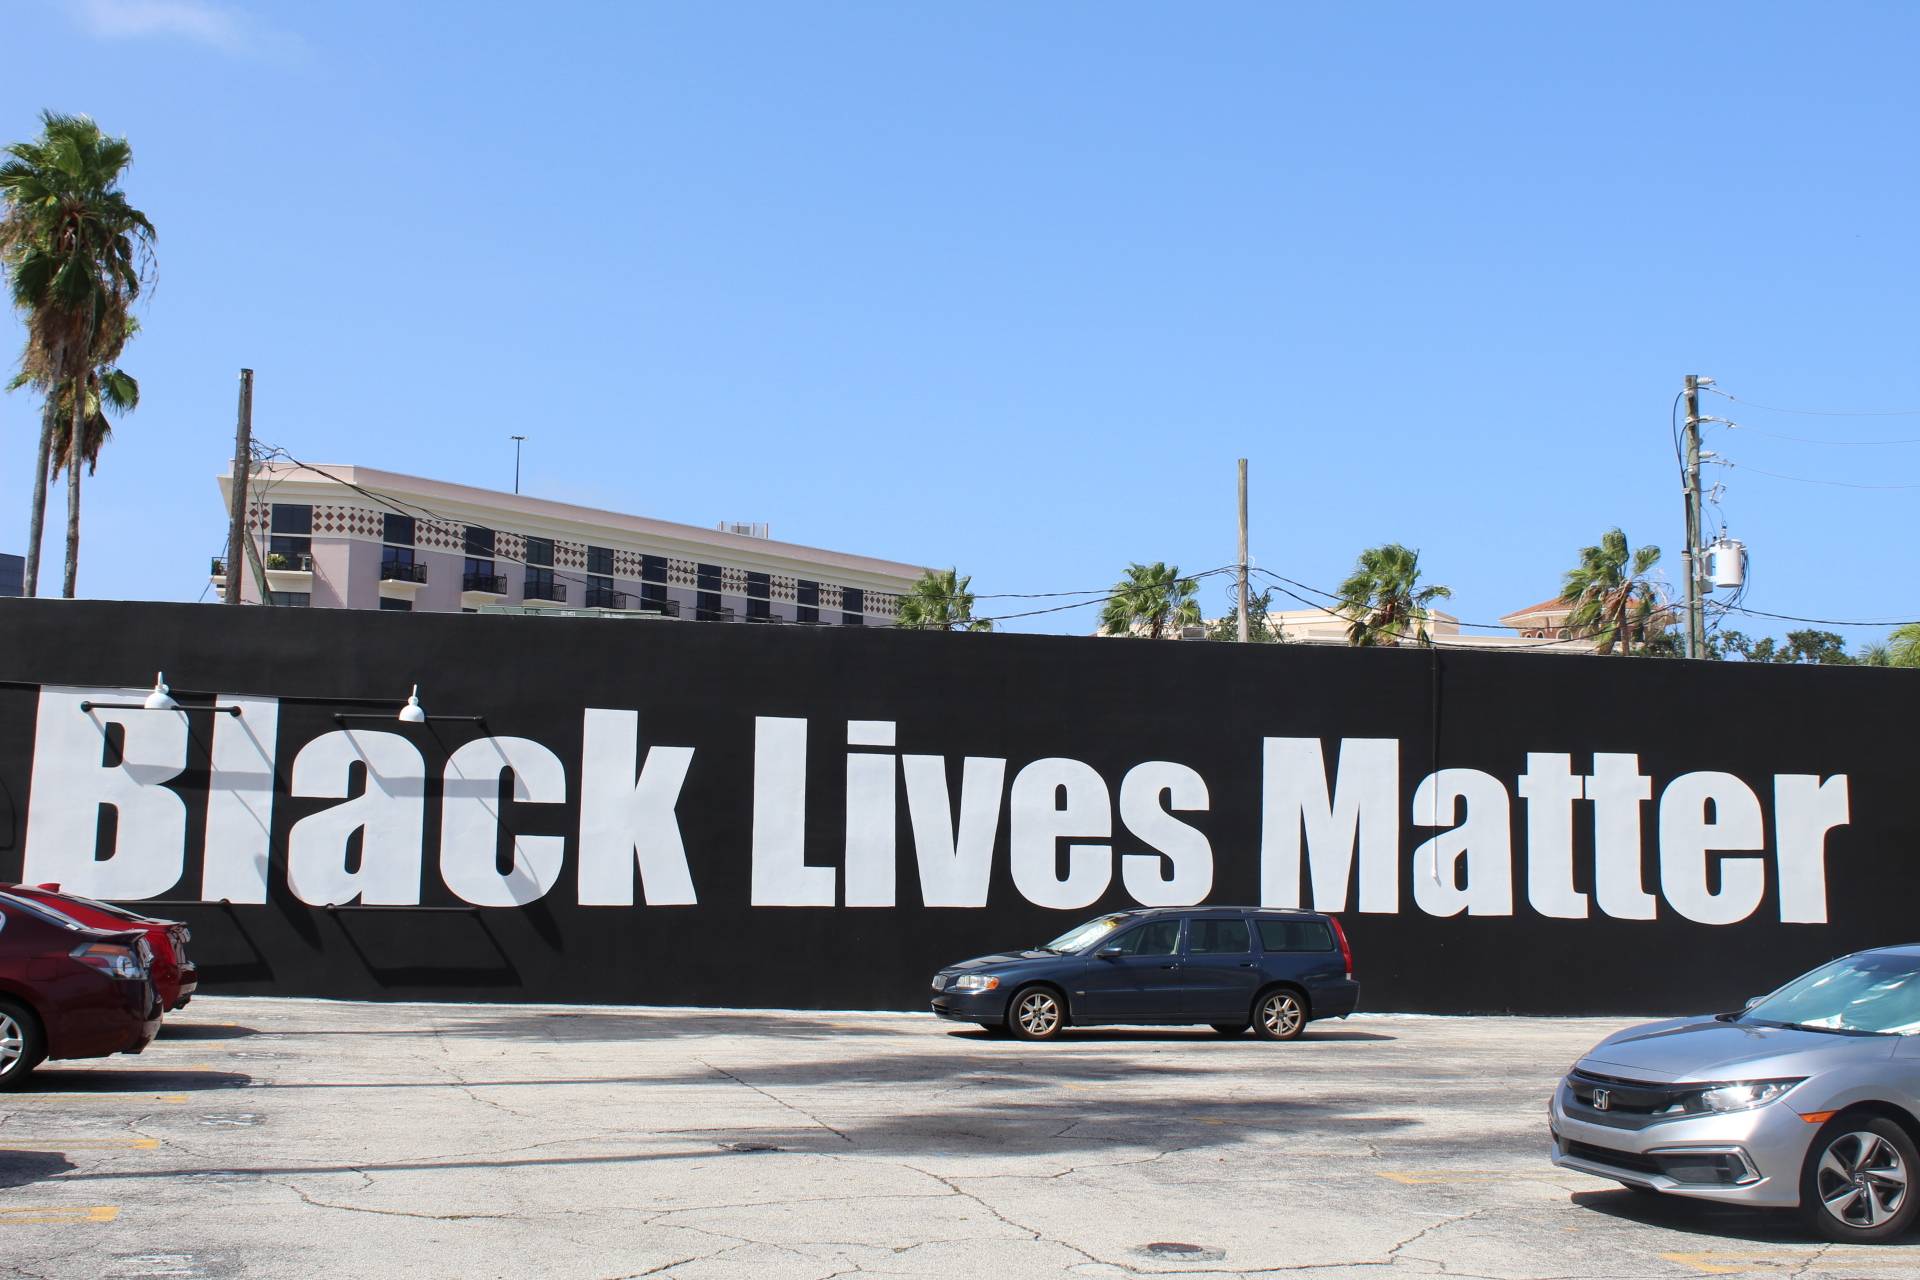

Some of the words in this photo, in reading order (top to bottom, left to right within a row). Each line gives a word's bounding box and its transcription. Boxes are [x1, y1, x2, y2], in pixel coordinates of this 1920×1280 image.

[24, 684, 698, 908] Black
[750, 715, 1214, 910] Lives
[1260, 736, 1850, 925] Matter
